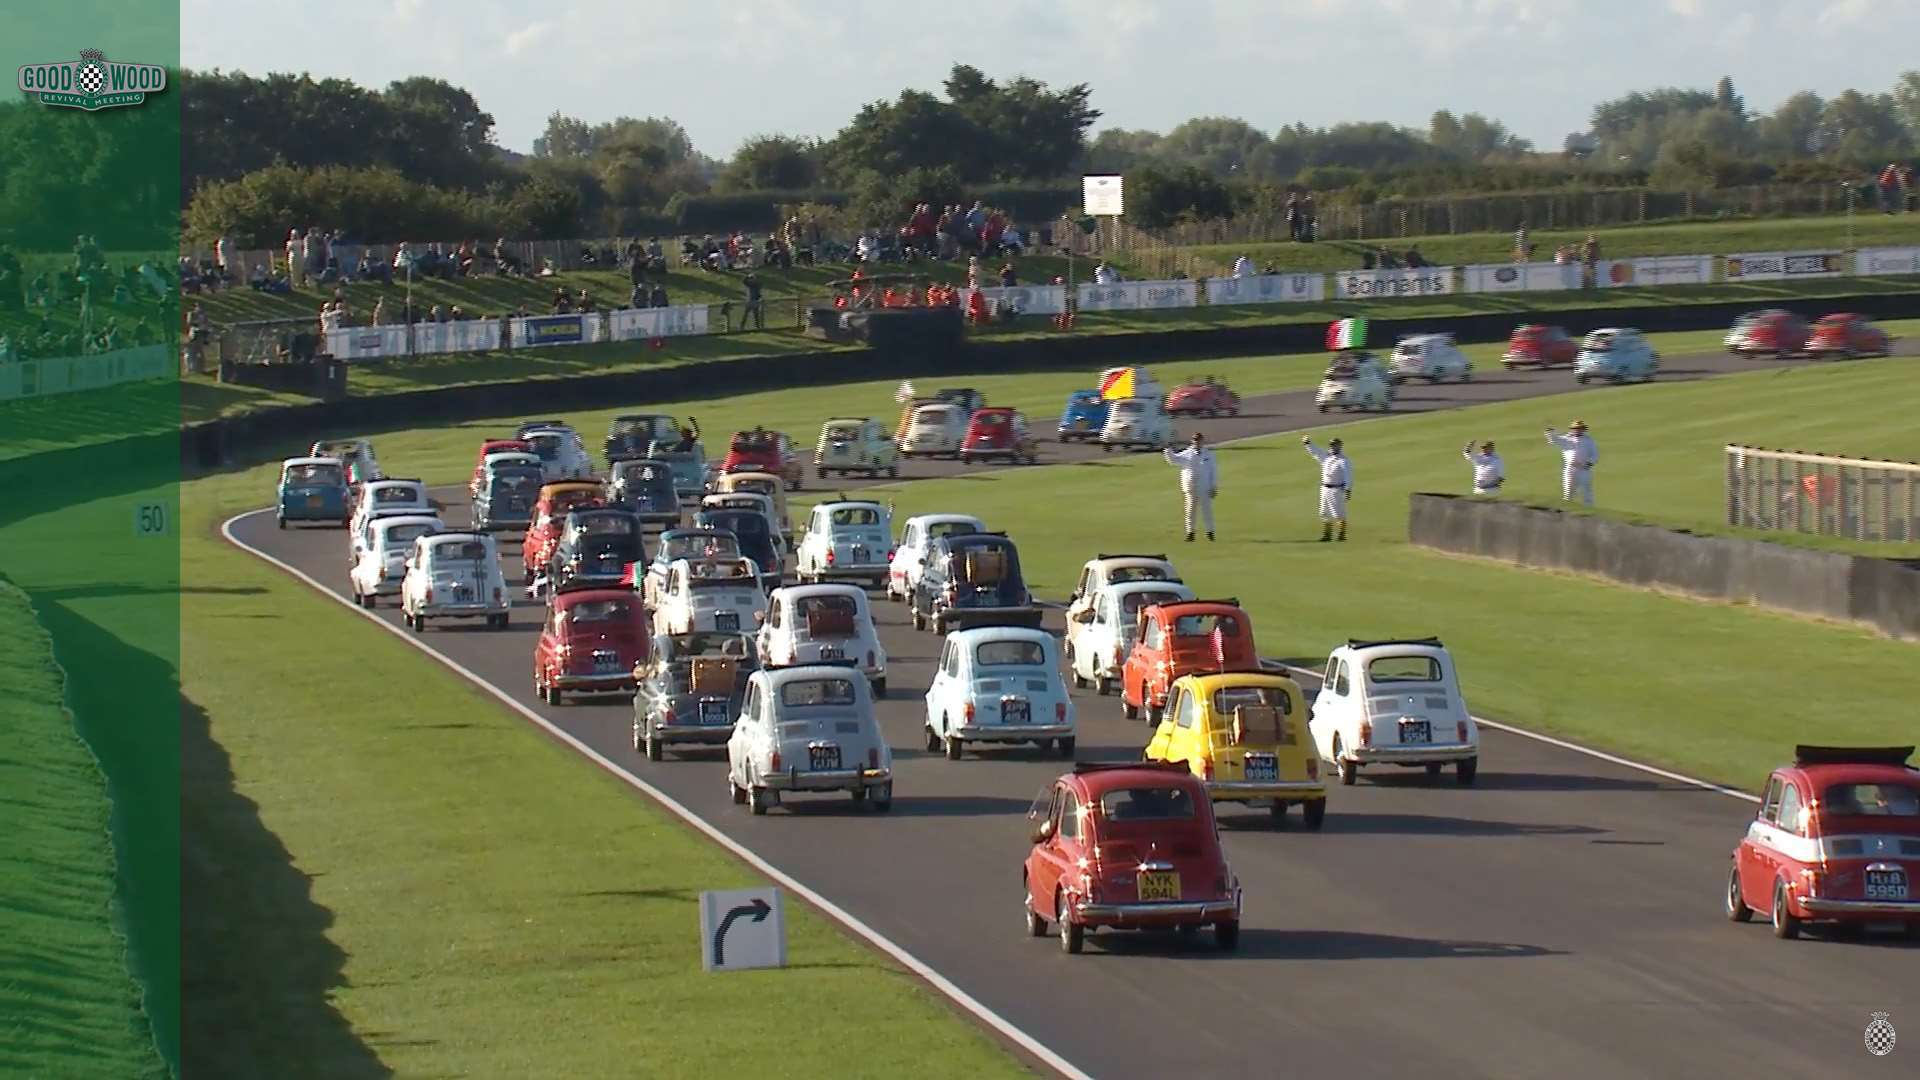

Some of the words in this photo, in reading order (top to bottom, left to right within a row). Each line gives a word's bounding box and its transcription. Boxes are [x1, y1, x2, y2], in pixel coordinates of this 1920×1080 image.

[1346, 274, 1445, 297] Bonhams
[142, 505, 163, 532] 50
[1145, 874, 1174, 886] NYK
[1867, 885, 1905, 897] 595D
